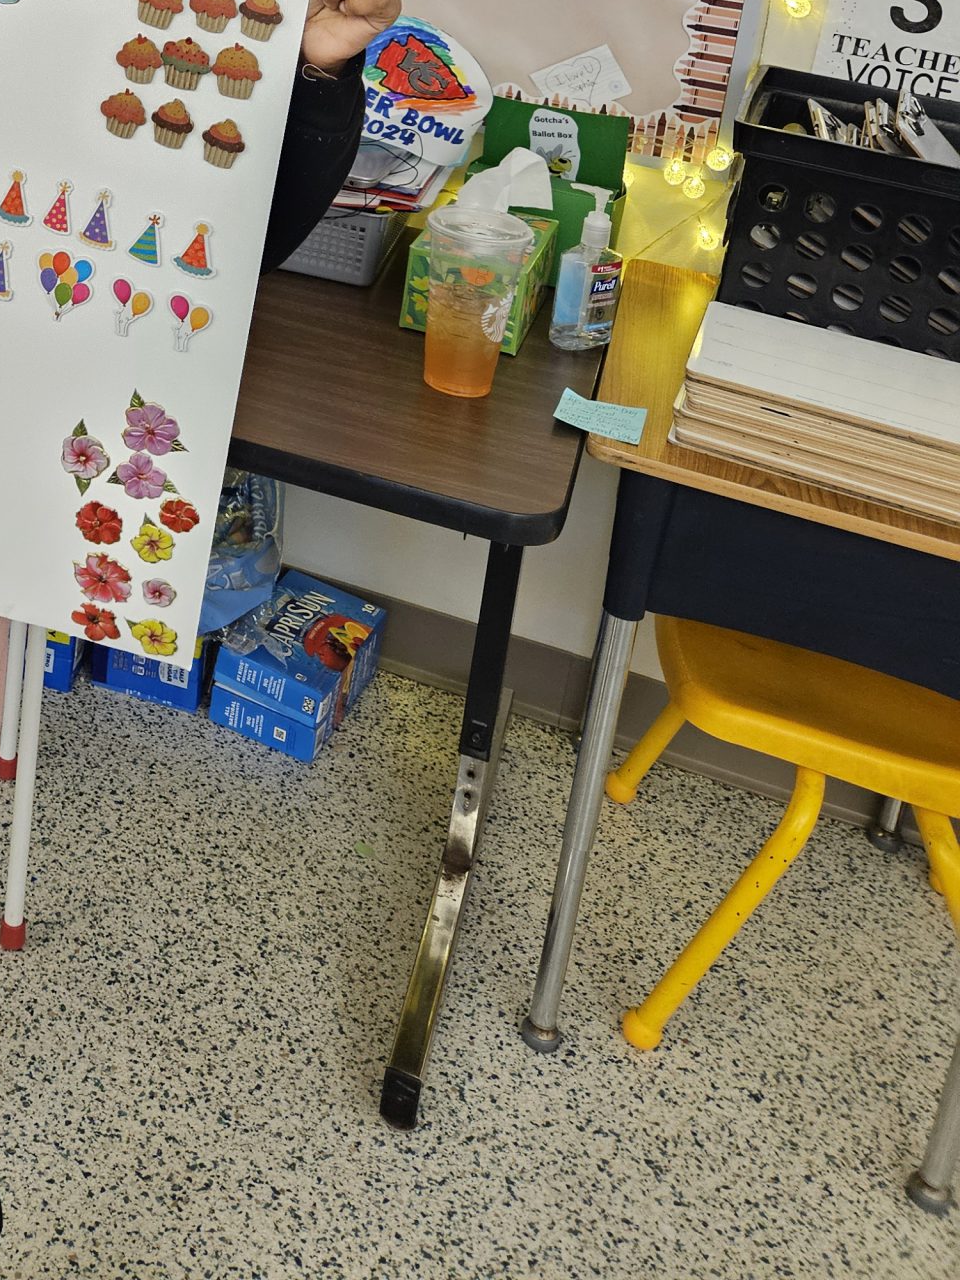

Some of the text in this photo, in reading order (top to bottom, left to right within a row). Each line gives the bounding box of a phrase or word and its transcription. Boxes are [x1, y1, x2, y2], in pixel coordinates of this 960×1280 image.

[833, 34, 960, 75] TEACHE
[534, 116, 569, 124] Gotcha's
[532, 130, 555, 138] Ballot
[594, 279, 616, 292] Purell
[362, 604, 375, 614] 10
